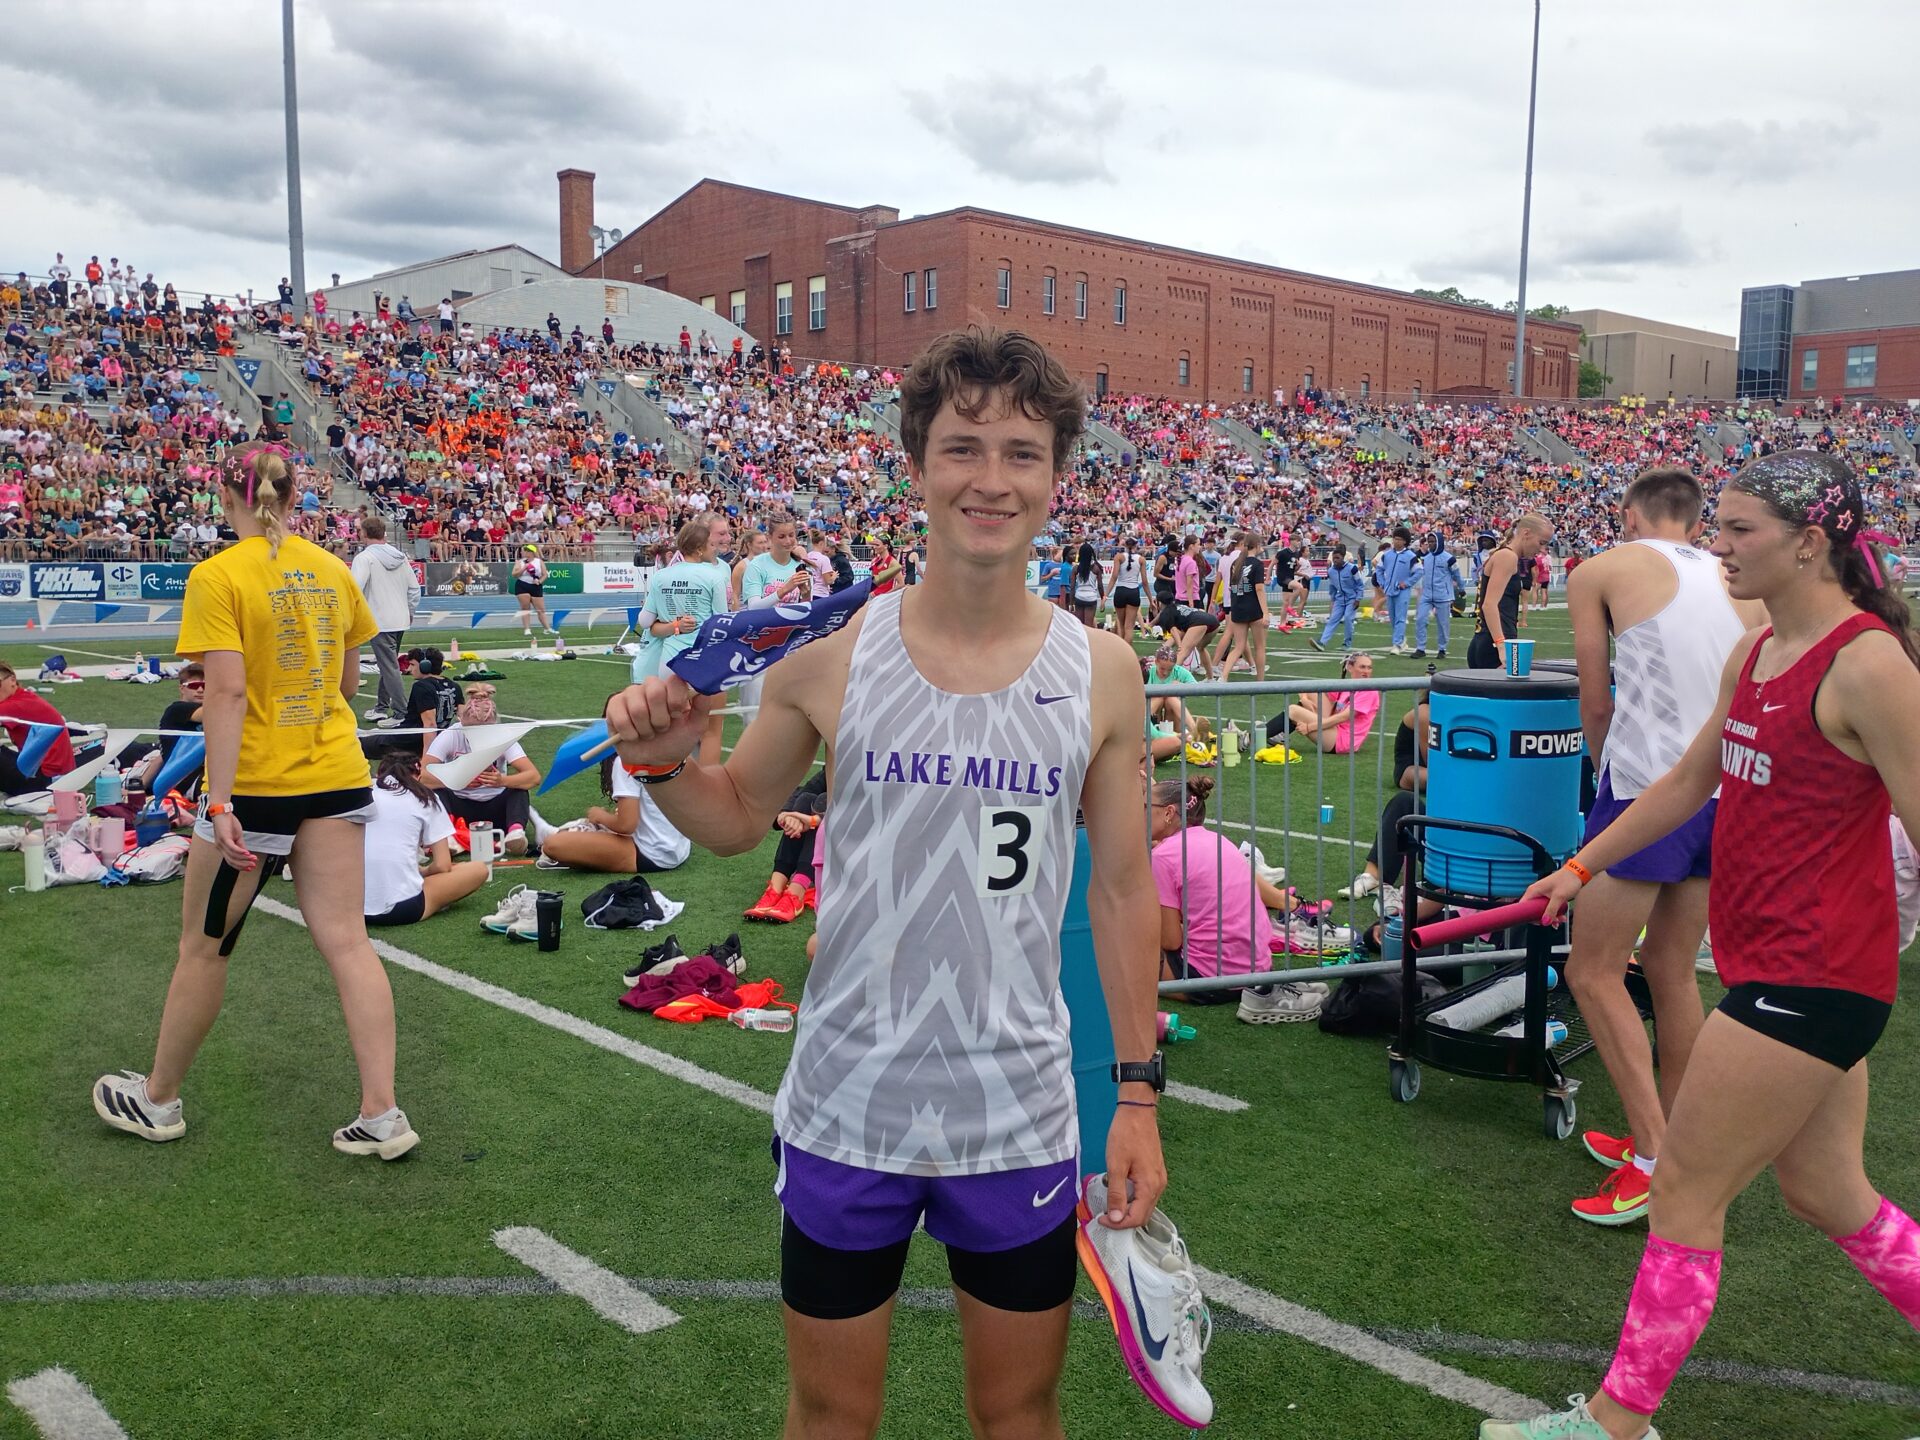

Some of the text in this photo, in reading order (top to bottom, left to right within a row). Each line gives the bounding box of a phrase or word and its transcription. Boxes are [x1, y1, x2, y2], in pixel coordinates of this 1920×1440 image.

[604, 566, 628, 575] Trixies
[436, 583, 499, 592] JOIN IOWA DPS
[272, 592, 339, 609] STATE
[865, 751, 1062, 797] LAKE MILLS
[987, 810, 1032, 891] 3
